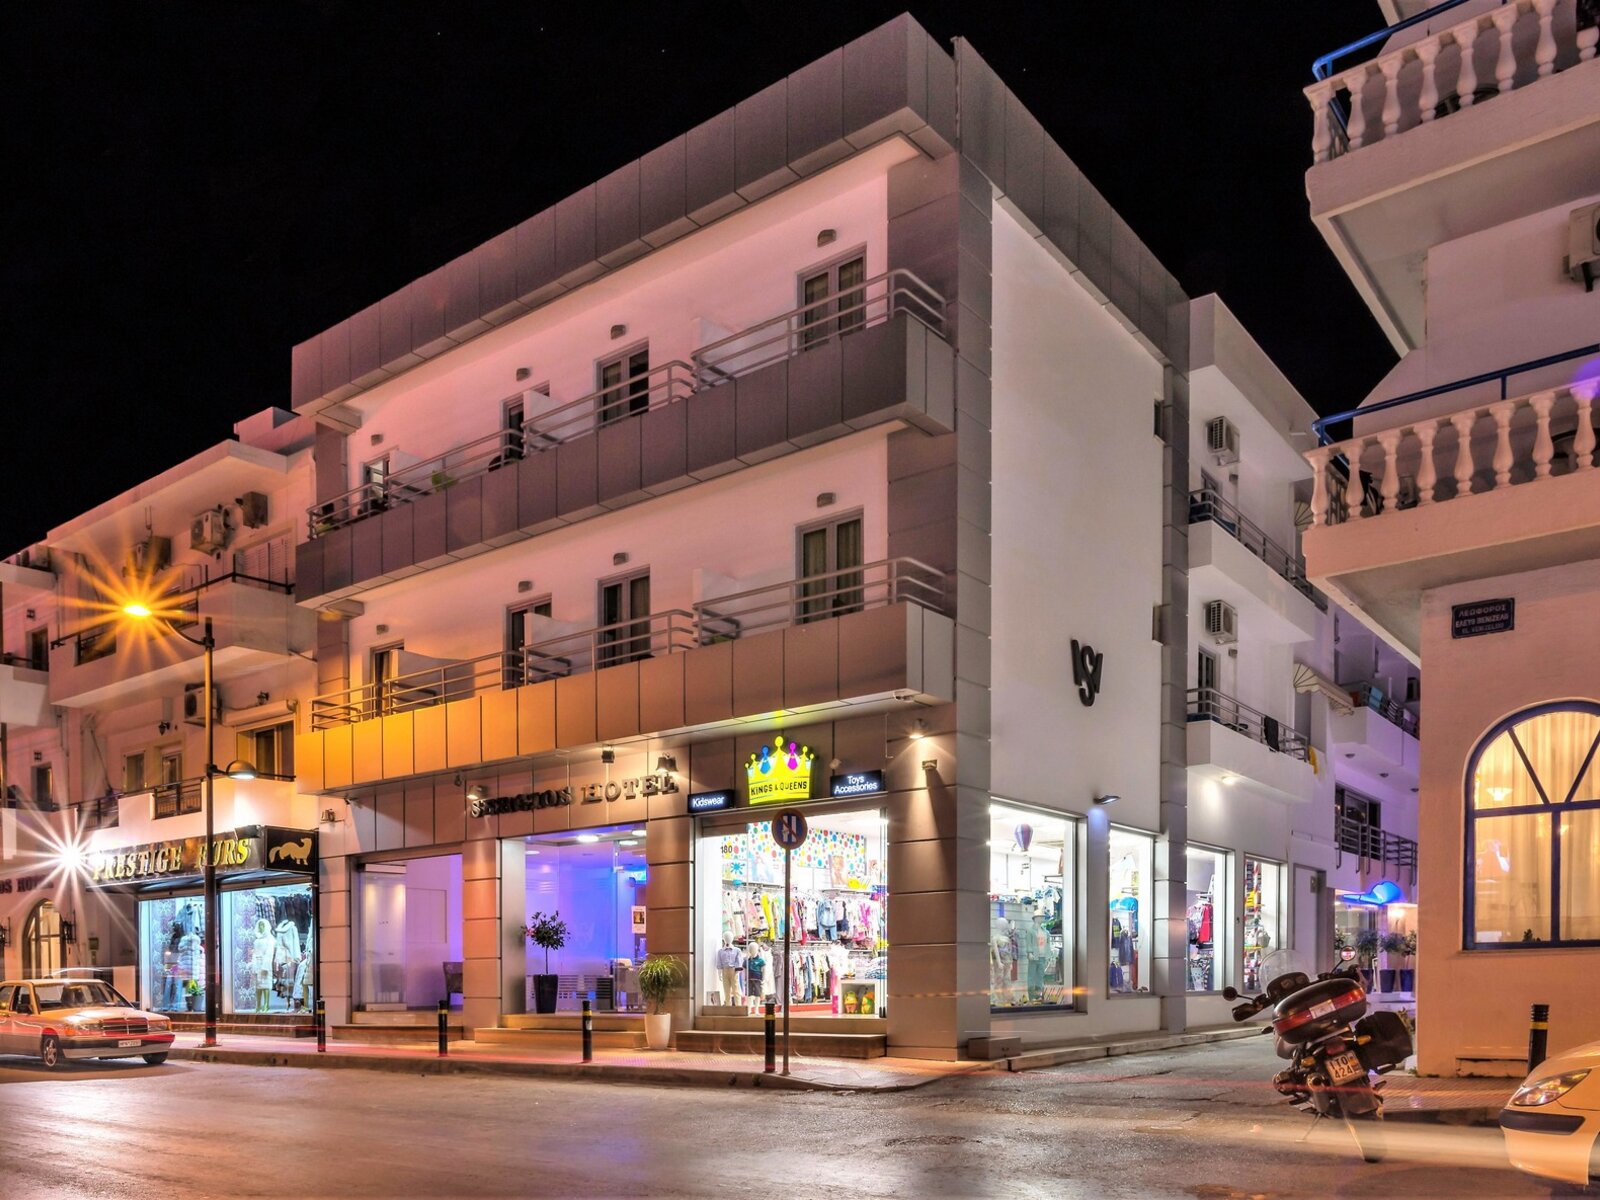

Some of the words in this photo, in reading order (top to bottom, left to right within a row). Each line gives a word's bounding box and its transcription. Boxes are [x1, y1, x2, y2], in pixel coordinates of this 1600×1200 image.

[846, 775, 865, 786] Toys
[580, 774, 679, 805] HOTEL
[750, 782, 774, 796] KINGS
[779, 780, 808, 793] QUEENS
[833, 781, 878, 795] Accessories
[691, 794, 726, 808] Kidswear
[720, 844, 733, 855] 180
[92, 846, 182, 881] PRESTIGE
[1334, 1064, 1352, 1078] 424
